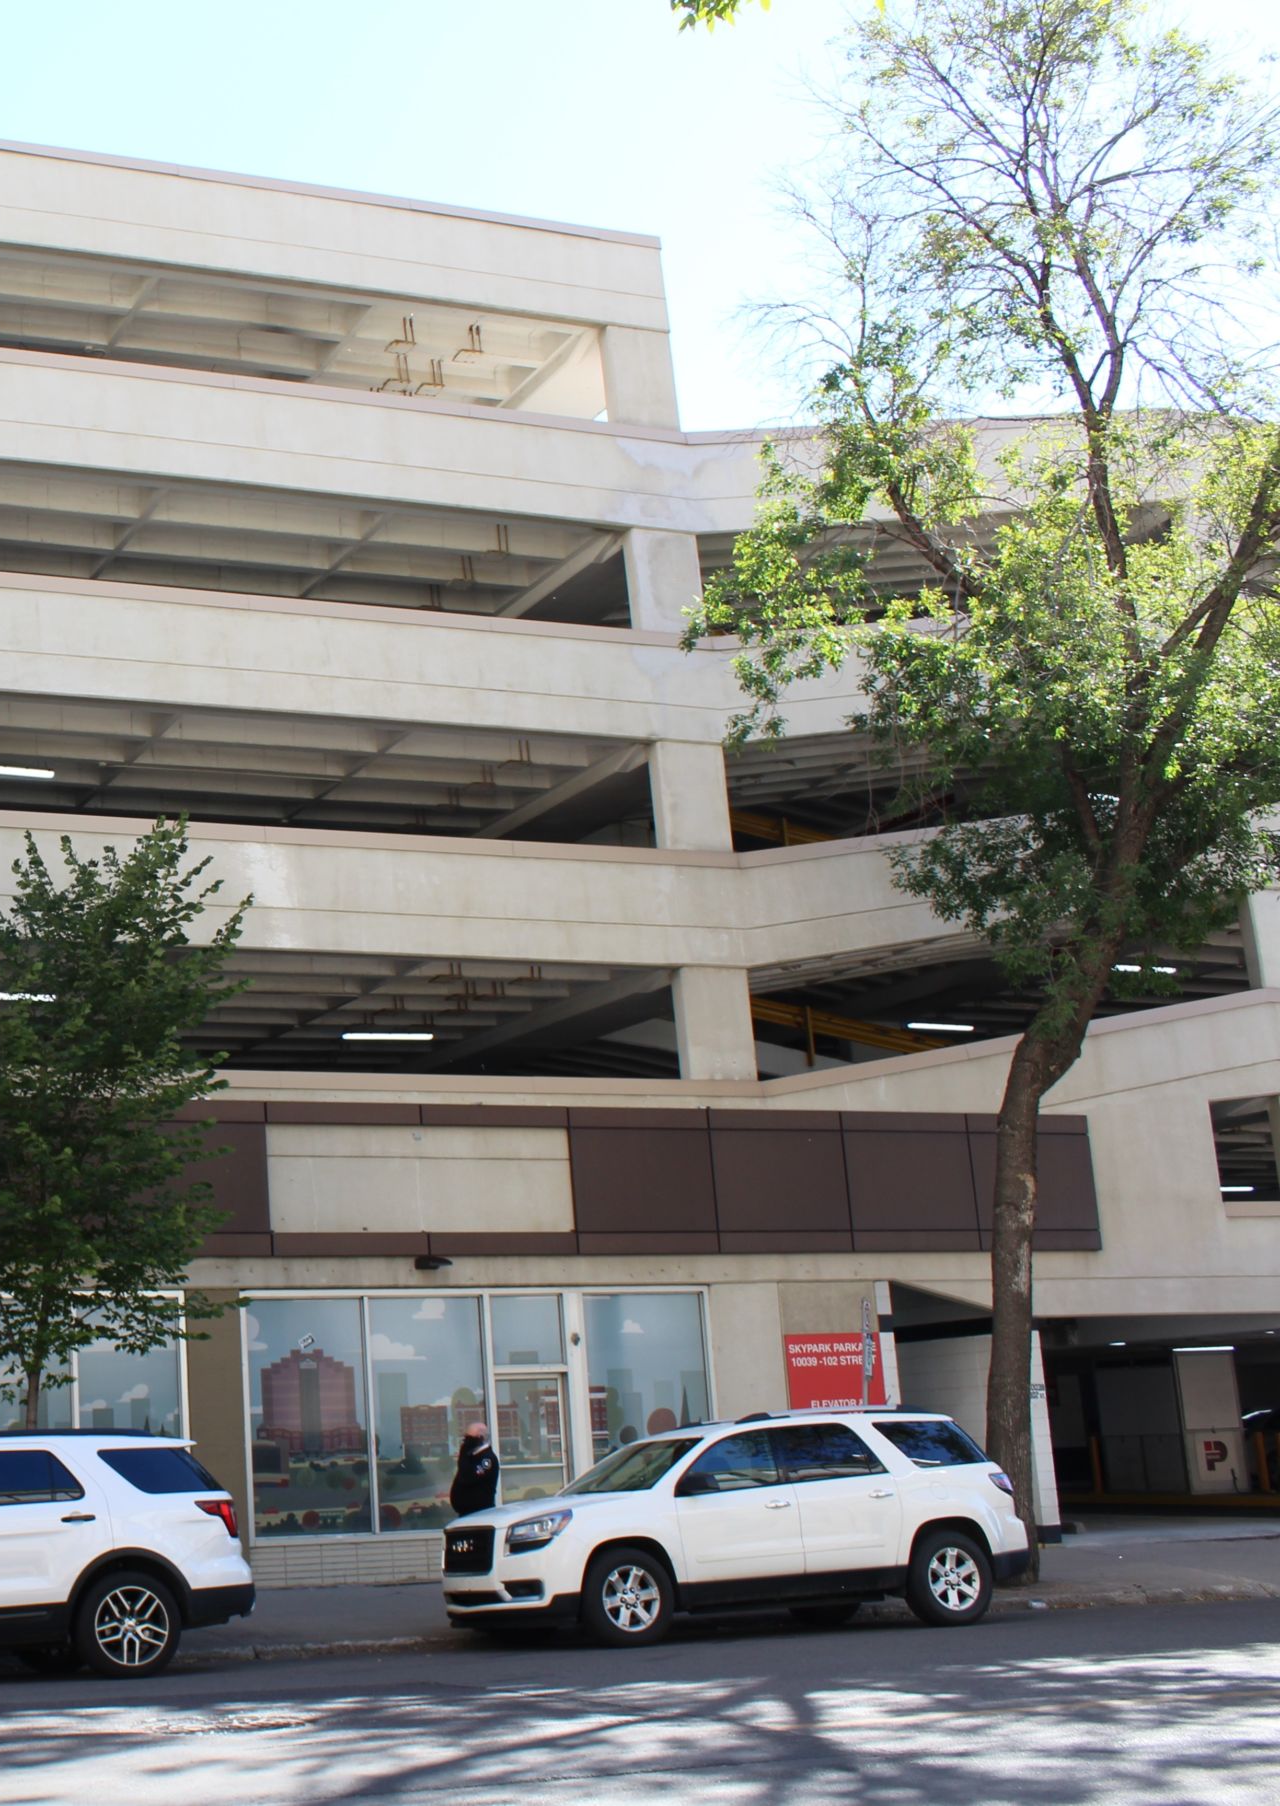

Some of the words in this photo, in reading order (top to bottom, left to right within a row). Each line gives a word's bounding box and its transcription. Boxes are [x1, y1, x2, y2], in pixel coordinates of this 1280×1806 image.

[788, 1343, 832, 1354] SKYPARK
[833, 1342, 877, 1353] PARKAE
[791, 1356, 818, 1367] 10039
[839, 1355, 877, 1366] STRET
[811, 1399, 858, 1409] ELEVATOR
